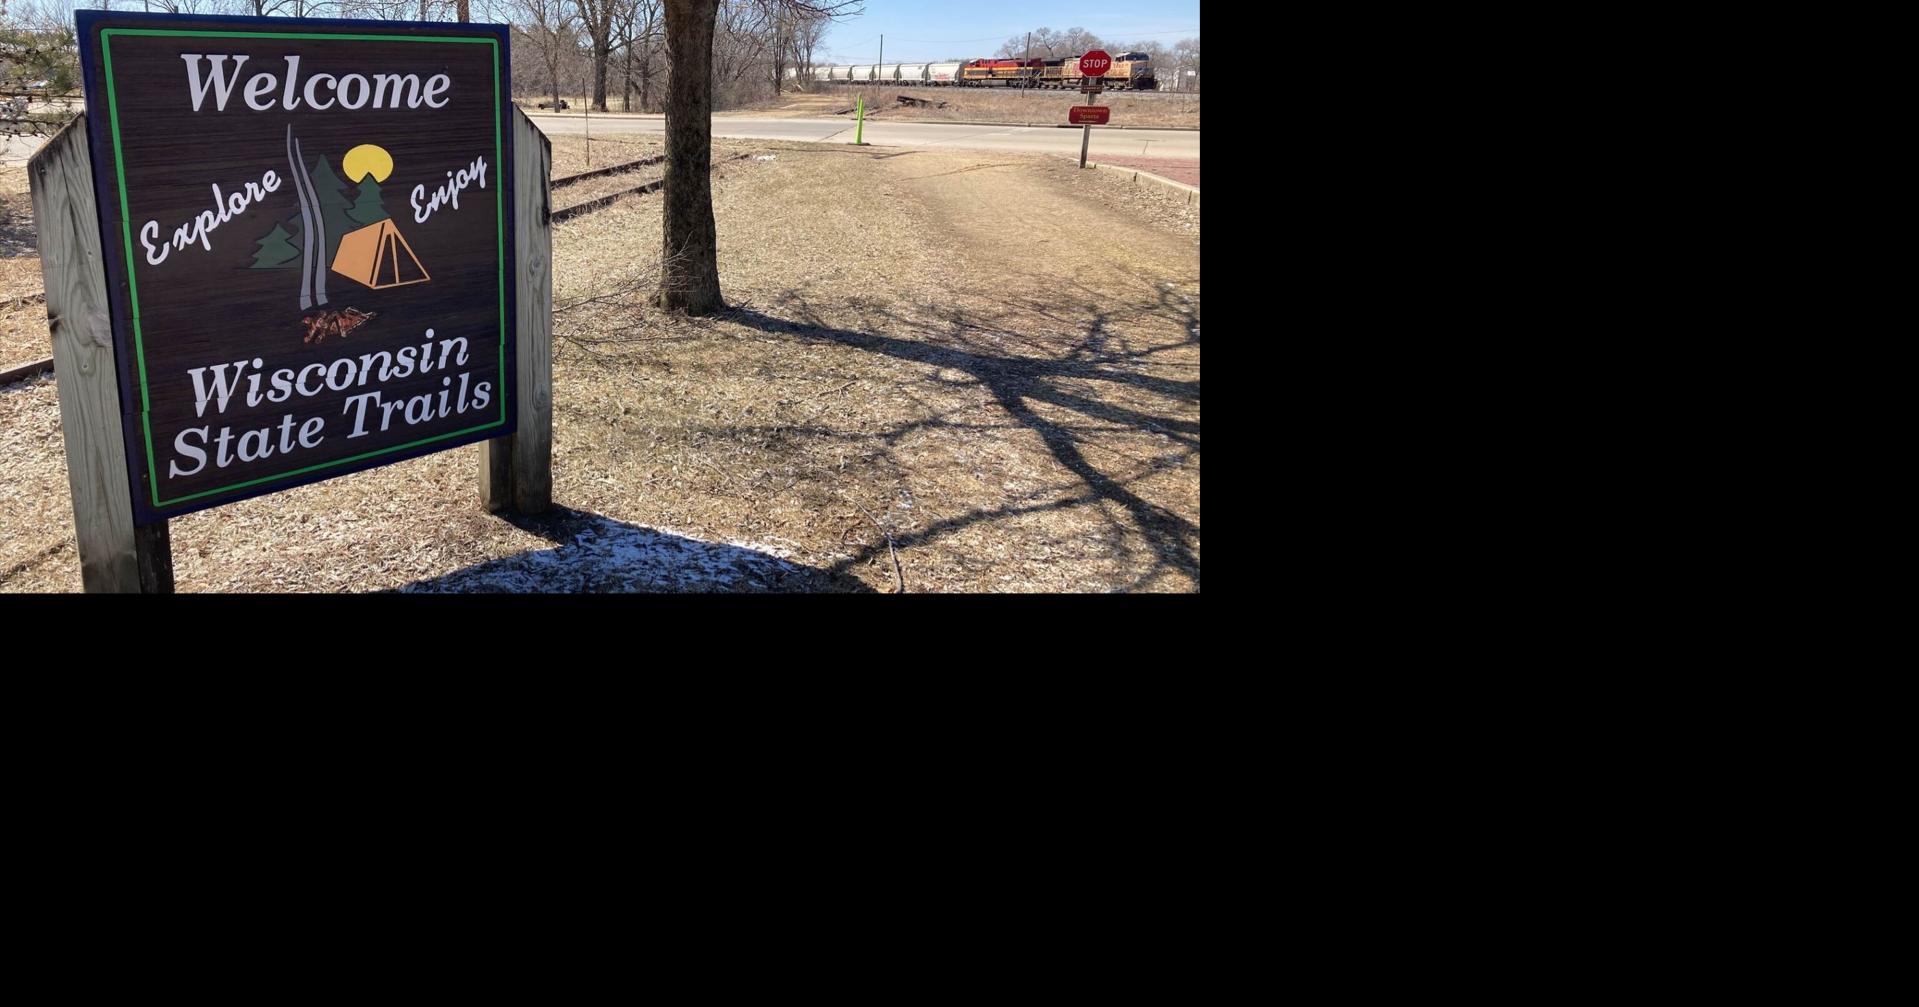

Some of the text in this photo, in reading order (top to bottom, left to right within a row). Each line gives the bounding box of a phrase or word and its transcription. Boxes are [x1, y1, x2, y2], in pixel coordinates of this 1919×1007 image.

[181, 53, 451, 112] Welcome
[1082, 59, 1108, 69] STOP
[139, 168, 282, 266] Explore
[410, 155, 488, 224] Enjoy
[187, 328, 470, 419] Wisconsin
[168, 372, 492, 480] State Trails
